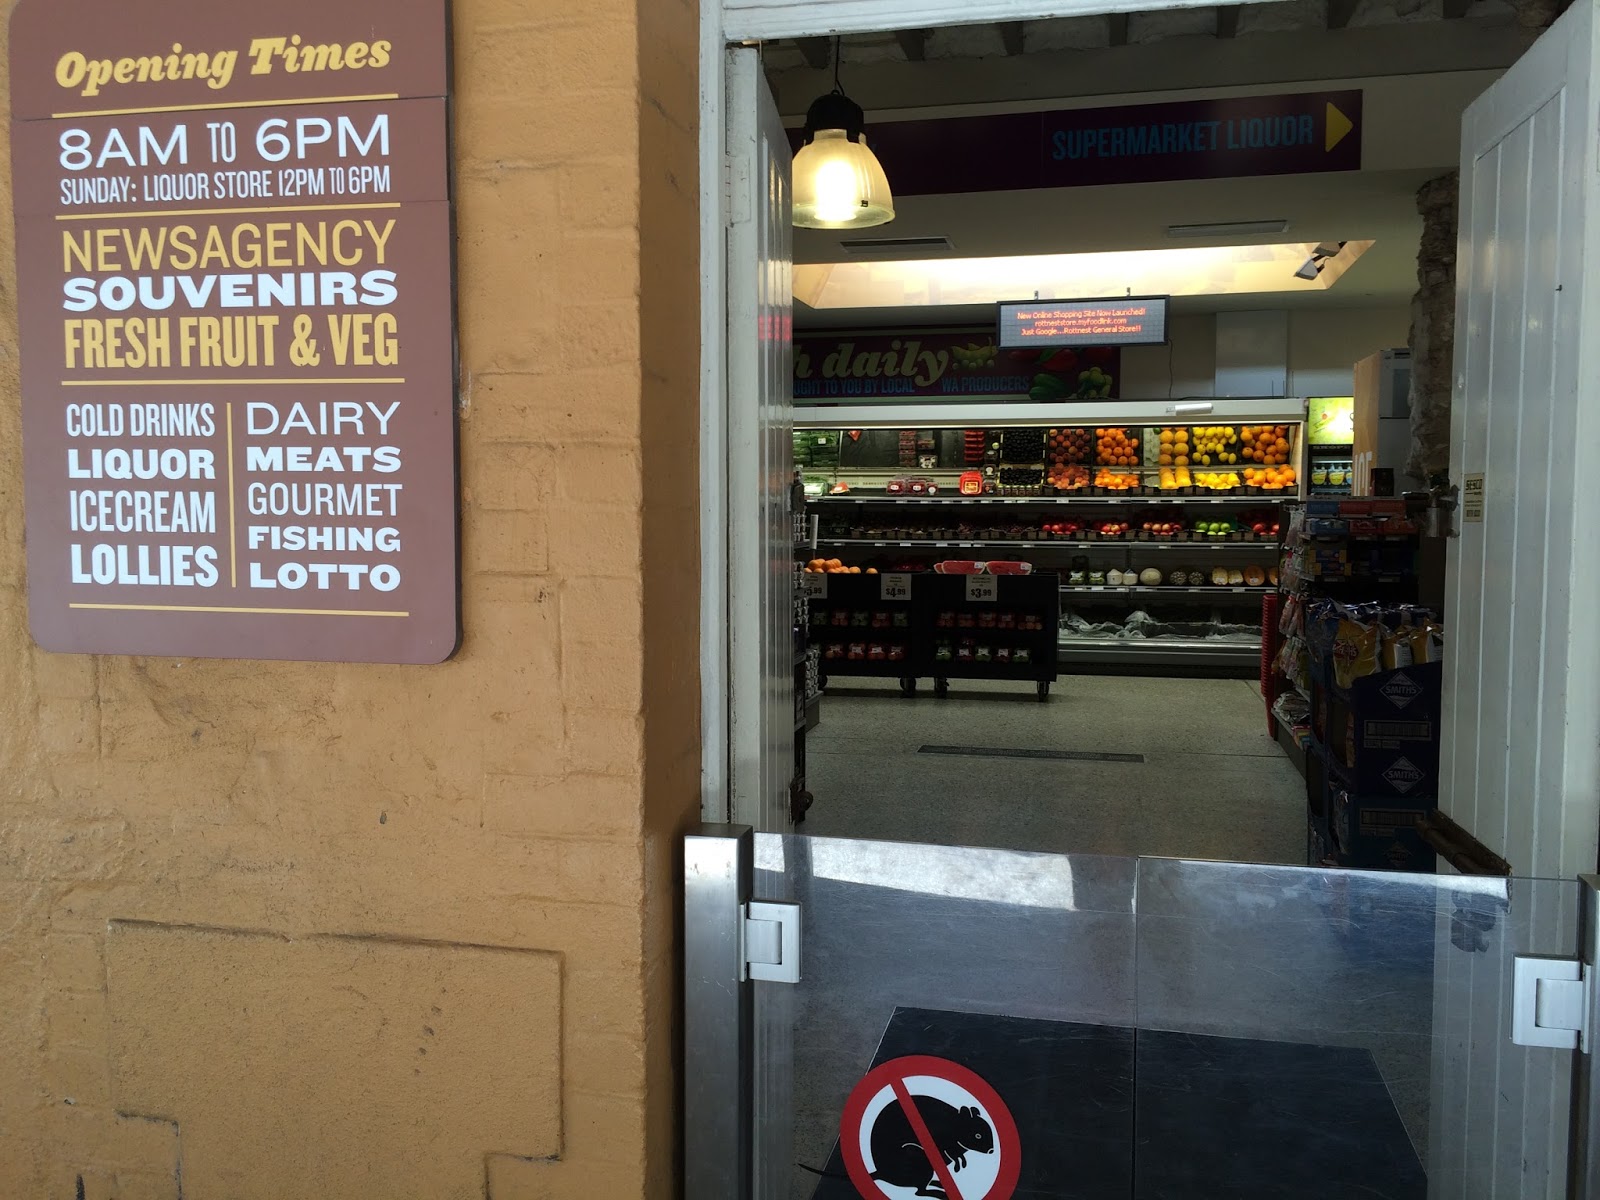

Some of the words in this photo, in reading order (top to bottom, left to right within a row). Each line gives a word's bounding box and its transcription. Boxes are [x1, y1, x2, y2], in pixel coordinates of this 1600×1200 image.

[56, 43, 238, 96] Opening
[249, 35, 391, 75] Times
[59, 125, 187, 170] 8AM
[206, 122, 236, 163] TO
[256, 114, 389, 161] 6PM
[1052, 121, 1221, 161] SUPERMARKET
[1227, 115, 1313, 150] LIQUOR
[60, 176, 136, 205] SUNDAY:
[144, 173, 210, 202] LIQUOR
[214, 170, 273, 199] STORE
[279, 168, 324, 196] 12PM
[329, 167, 344, 195] TO
[348, 166, 390, 194] 6PM
[62, 219, 396, 272] NEWSAGENCY
[63, 270, 398, 312] SOUVENIRS
[1017, 312, 1032, 320] New
[1033, 311, 1053, 319] Online
[1053, 310, 1083, 319] Shopping
[1083, 310, 1096, 318] Site
[1096, 309, 1111, 317] Now
[1021, 328, 1035, 336] Just
[1092, 325, 1117, 334] General
[64, 317, 170, 369] FRESH
[180, 316, 279, 367] FRUIT
[289, 314, 320, 366] &
[328, 313, 398, 366] VEG
[822, 340, 949, 387] daily
[825, 379, 838, 394] TO
[841, 378, 861, 394] YOU
[863, 378, 878, 393] BY
[881, 377, 915, 393] LOCAL
[941, 377, 960, 392] WA
[961, 375, 1030, 392] PRODUCERS
[66, 403, 124, 437] COLD
[130, 403, 215, 437] DRINKS
[247, 402, 400, 435] DAIRY
[68, 448, 216, 480] LIQUOR
[246, 446, 401, 473] MEATS
[69, 489, 216, 533] ICECREAM
[247, 482, 403, 516] GOURMET
[248, 526, 400, 552] FISHING
[70, 543, 219, 588] LOLLIES
[250, 562, 400, 591] LOTTO
[1386, 685, 1417, 695] SMITHS
[1388, 770, 1419, 780] SMITHS
